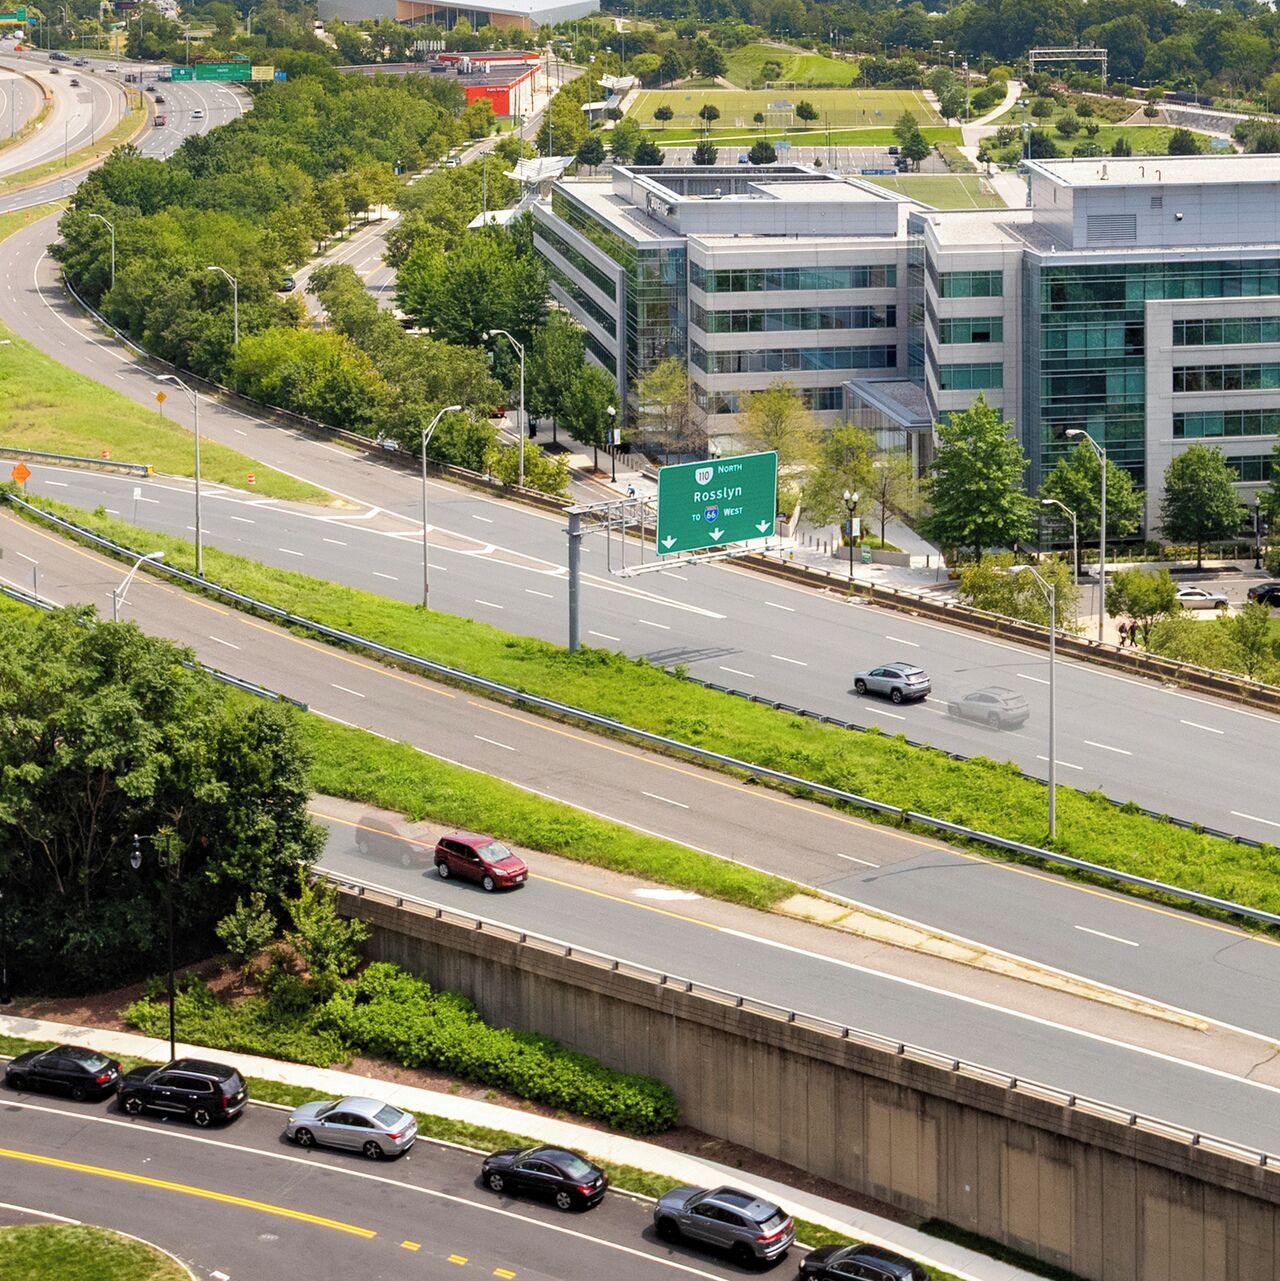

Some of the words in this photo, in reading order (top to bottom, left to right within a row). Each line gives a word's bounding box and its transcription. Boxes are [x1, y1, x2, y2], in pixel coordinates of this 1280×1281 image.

[699, 471, 709, 481] 110
[718, 464, 742, 474] NORTH
[694, 487, 742, 502] Rosslyn
[692, 513, 701, 521] TO
[706, 511, 716, 519] 66
[723, 507, 743, 516] WEST
